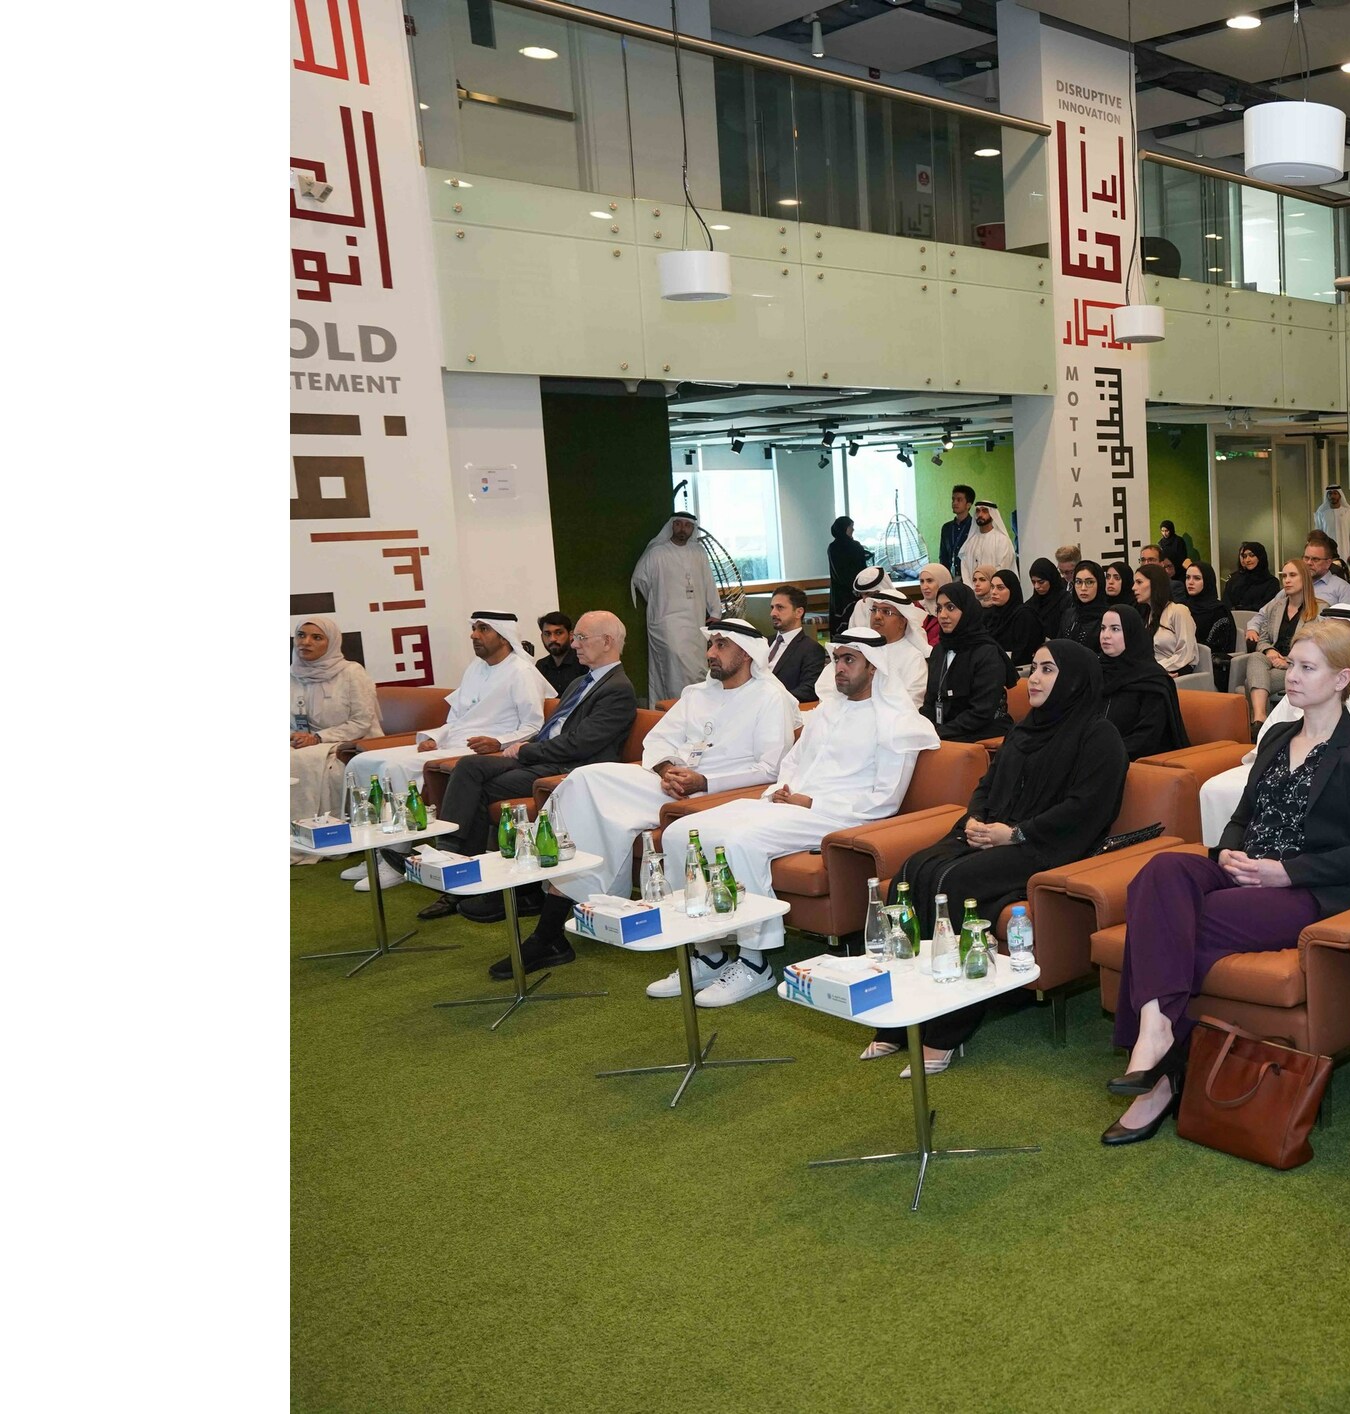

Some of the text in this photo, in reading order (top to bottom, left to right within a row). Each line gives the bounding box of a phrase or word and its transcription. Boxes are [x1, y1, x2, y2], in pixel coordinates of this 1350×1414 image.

[1056, 79, 1122, 109] DISRUPTIVE
[1058, 98, 1121, 125] INNOVATION
[290, 371, 401, 394] TEMENT
